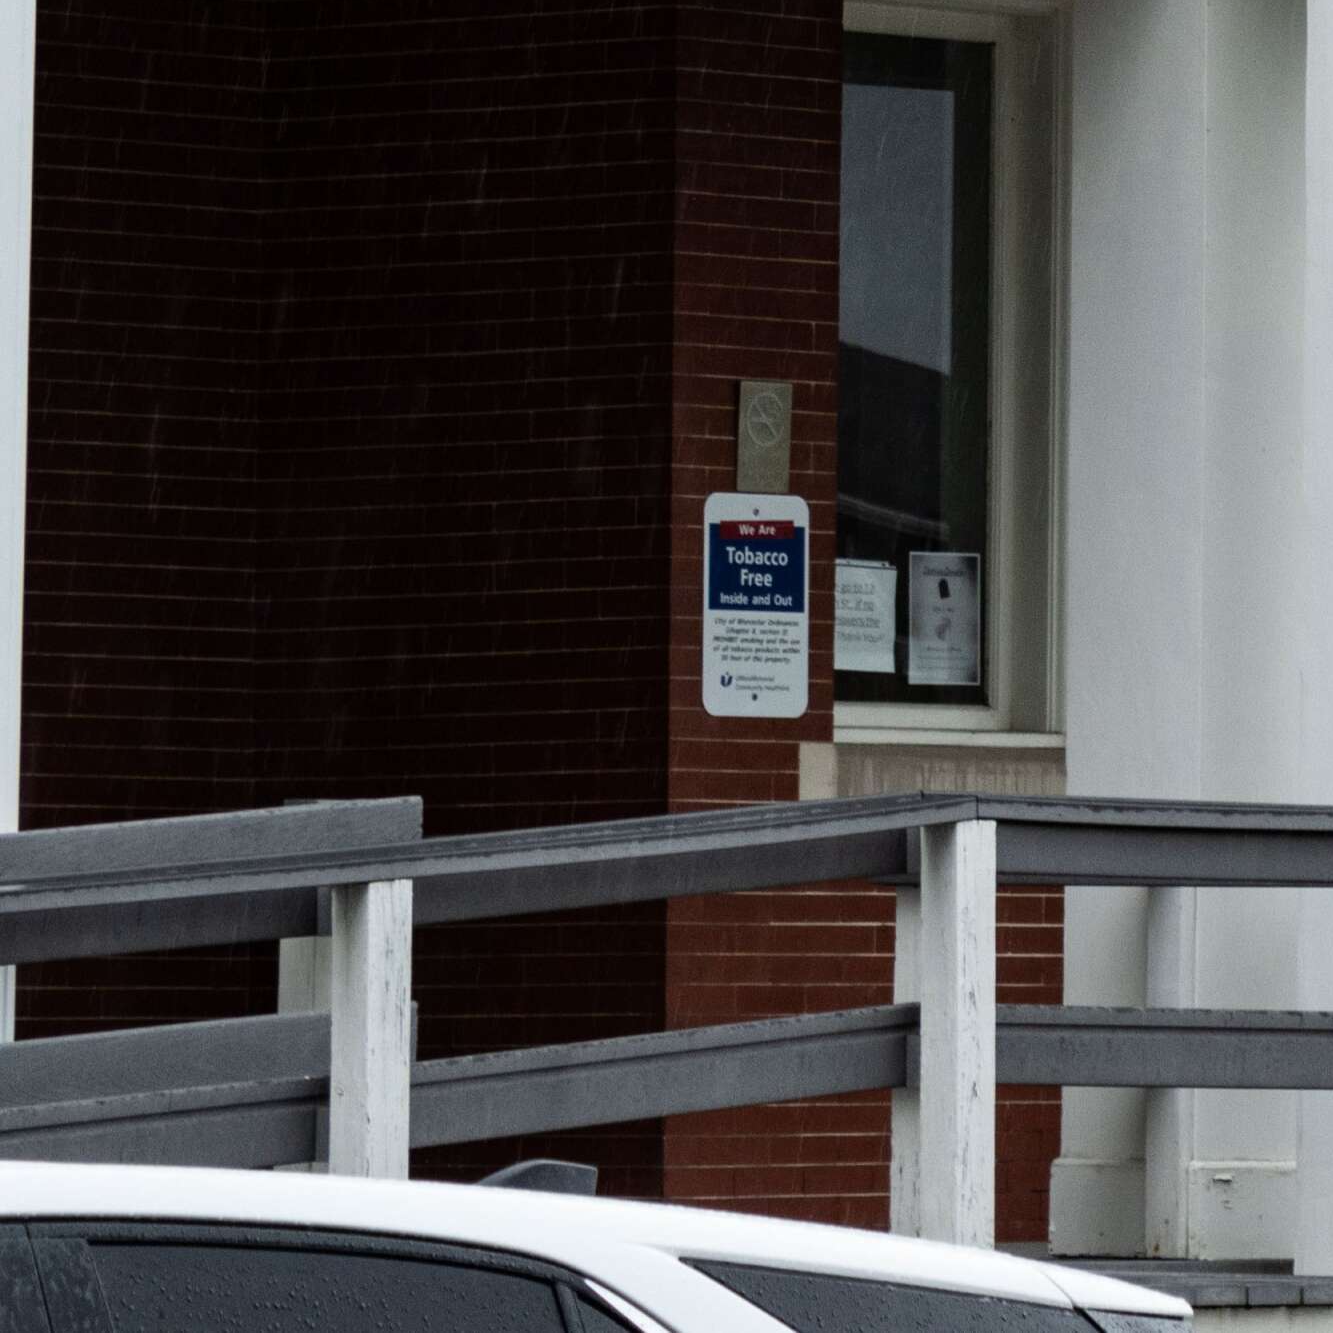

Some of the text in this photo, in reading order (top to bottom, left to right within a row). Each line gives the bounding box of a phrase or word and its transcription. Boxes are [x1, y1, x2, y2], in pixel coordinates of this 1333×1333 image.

[738, 524, 776, 536] We Are
[726, 546, 789, 566] Tobacco
[740, 568, 773, 587] Free
[720, 592, 792, 606] Inside and Out
